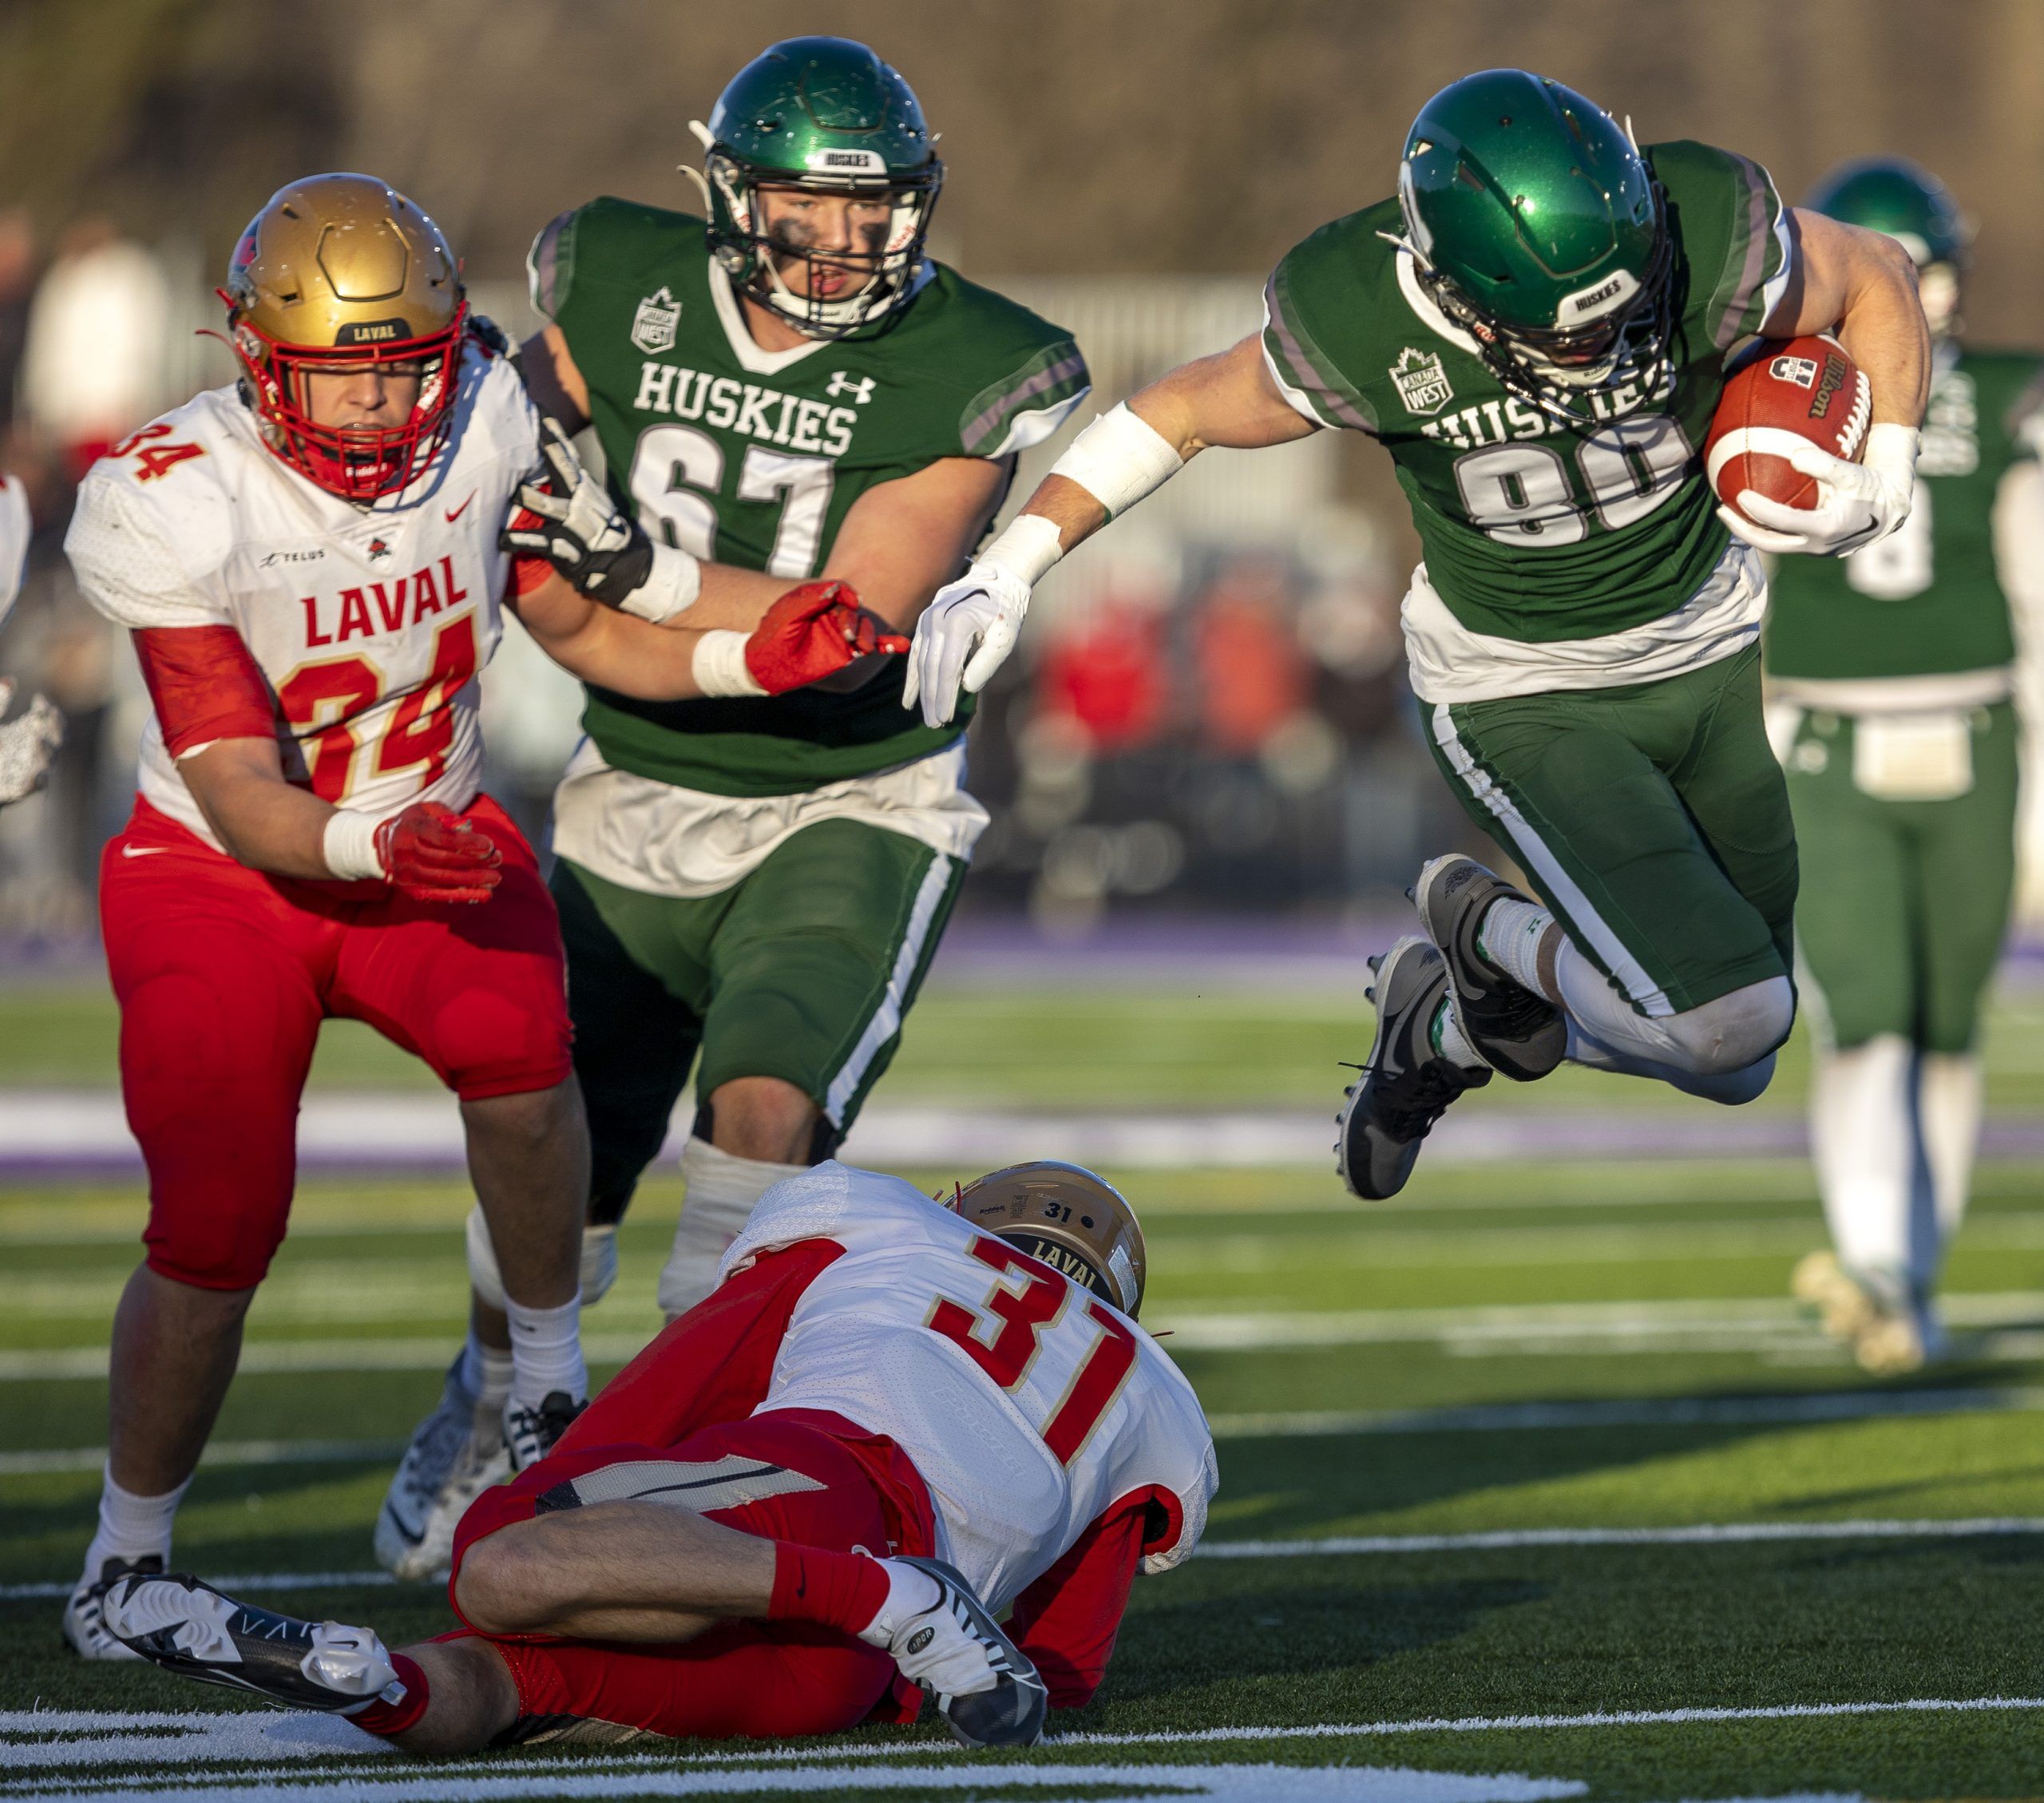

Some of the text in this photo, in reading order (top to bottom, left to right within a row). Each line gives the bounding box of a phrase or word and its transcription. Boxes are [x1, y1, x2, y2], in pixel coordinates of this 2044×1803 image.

[1575, 279, 1621, 311] HUSKIES
[354, 325, 396, 342] LAVAL
[1402, 368, 1440, 389] CANADA
[1407, 382, 1447, 410] WEST
[1808, 352, 1847, 418] Wilson
[633, 361, 858, 457] HUSKIES
[628, 422, 837, 578] 67
[1452, 412, 1696, 548] 80
[283, 549, 325, 561] TELUS
[299, 554, 467, 648] LAVAL
[979, 1204, 1005, 1215] Riddell
[1044, 1202, 1072, 1223] 31
[1032, 1240, 1097, 1291] LAVAL
[921, 1232, 1140, 1472] 31
